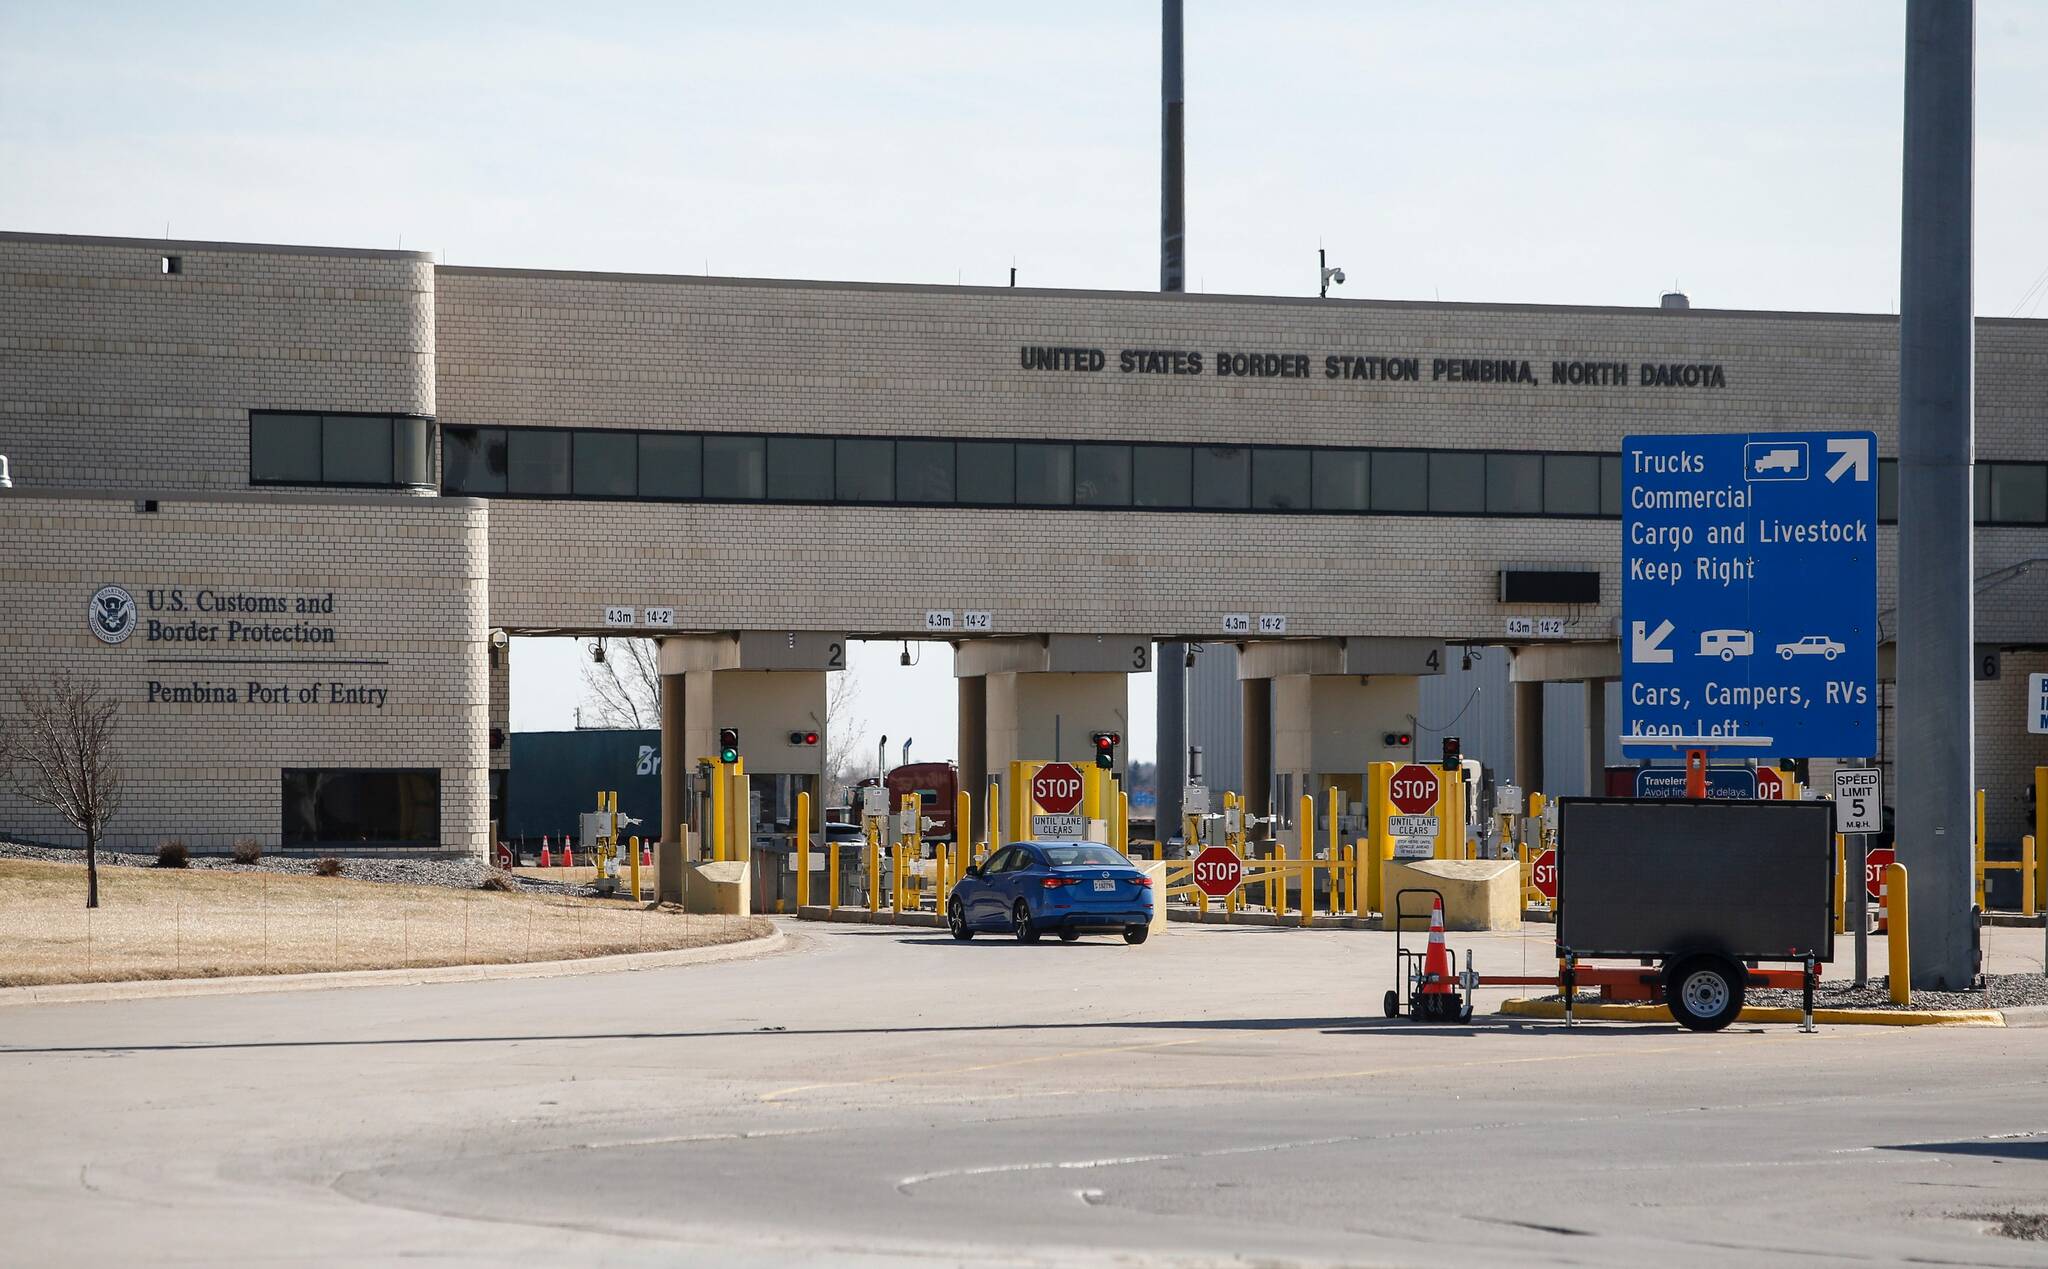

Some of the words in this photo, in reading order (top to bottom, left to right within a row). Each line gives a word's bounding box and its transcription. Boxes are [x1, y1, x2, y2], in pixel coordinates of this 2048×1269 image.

[1021, 346, 1105, 371] UNITED
[1120, 350, 1203, 375] STATES
[1216, 352, 1310, 378] BORDER
[1325, 355, 1419, 381] STATION
[1433, 358, 1538, 386] PEMBINA,
[1551, 361, 1628, 386] NORTH
[1641, 363, 1726, 388] DAKOTA
[1631, 450, 1704, 473] Trucks
[1631, 485, 1752, 509] Commercial
[1631, 521, 1693, 552] Cargo
[1707, 522, 1745, 544] and
[1759, 519, 1867, 543] Livestock
[1631, 557, 1682, 586] Keep
[1696, 556, 1755, 587] Right
[147, 590, 188, 612] U.S.
[197, 590, 287, 613] Customs
[295, 593, 334, 613] and
[608, 610, 631, 623] 4.3m
[928, 614, 951, 627] 4.3m
[1225, 618, 1247, 629] 4.3m
[147, 620, 219, 642] Border
[227, 620, 335, 643] Protection
[1509, 621, 1530, 633] 4.3m
[829, 643, 842, 666] 2
[1133, 646, 1146, 669] 3
[1426, 649, 1440, 671] 4
[1983, 656, 1996, 677] 6
[147, 681, 238, 704] Pembina
[247, 682, 290, 704] Port
[299, 682, 322, 705] of
[330, 682, 388, 708] Entry
[1631, 682, 1690, 710] Cars,
[1705, 682, 1811, 710] Campers,
[1826, 681, 1867, 704] RVs
[1036, 779, 1080, 798] STOP
[1644, 776, 1688, 786] Traveler
[1837, 775, 1877, 785] SPEED
[1393, 780, 1436, 799] STOP
[1644, 787, 1669, 797] Avoid
[1757, 782, 1780, 800] OP
[1842, 787, 1872, 797] LIMIT
[1852, 799, 1866, 817] 5
[1035, 817, 1060, 825] UNTIL
[1061, 817, 1081, 826] LANE
[1043, 826, 1073, 834] CLEARS
[1391, 818, 1413, 826] UNTIL
[1417, 818, 1437, 827] LANE
[1399, 827, 1428, 835] CLEARS
[1197, 862, 1238, 880] STOP
[1536, 865, 1558, 883] ST
